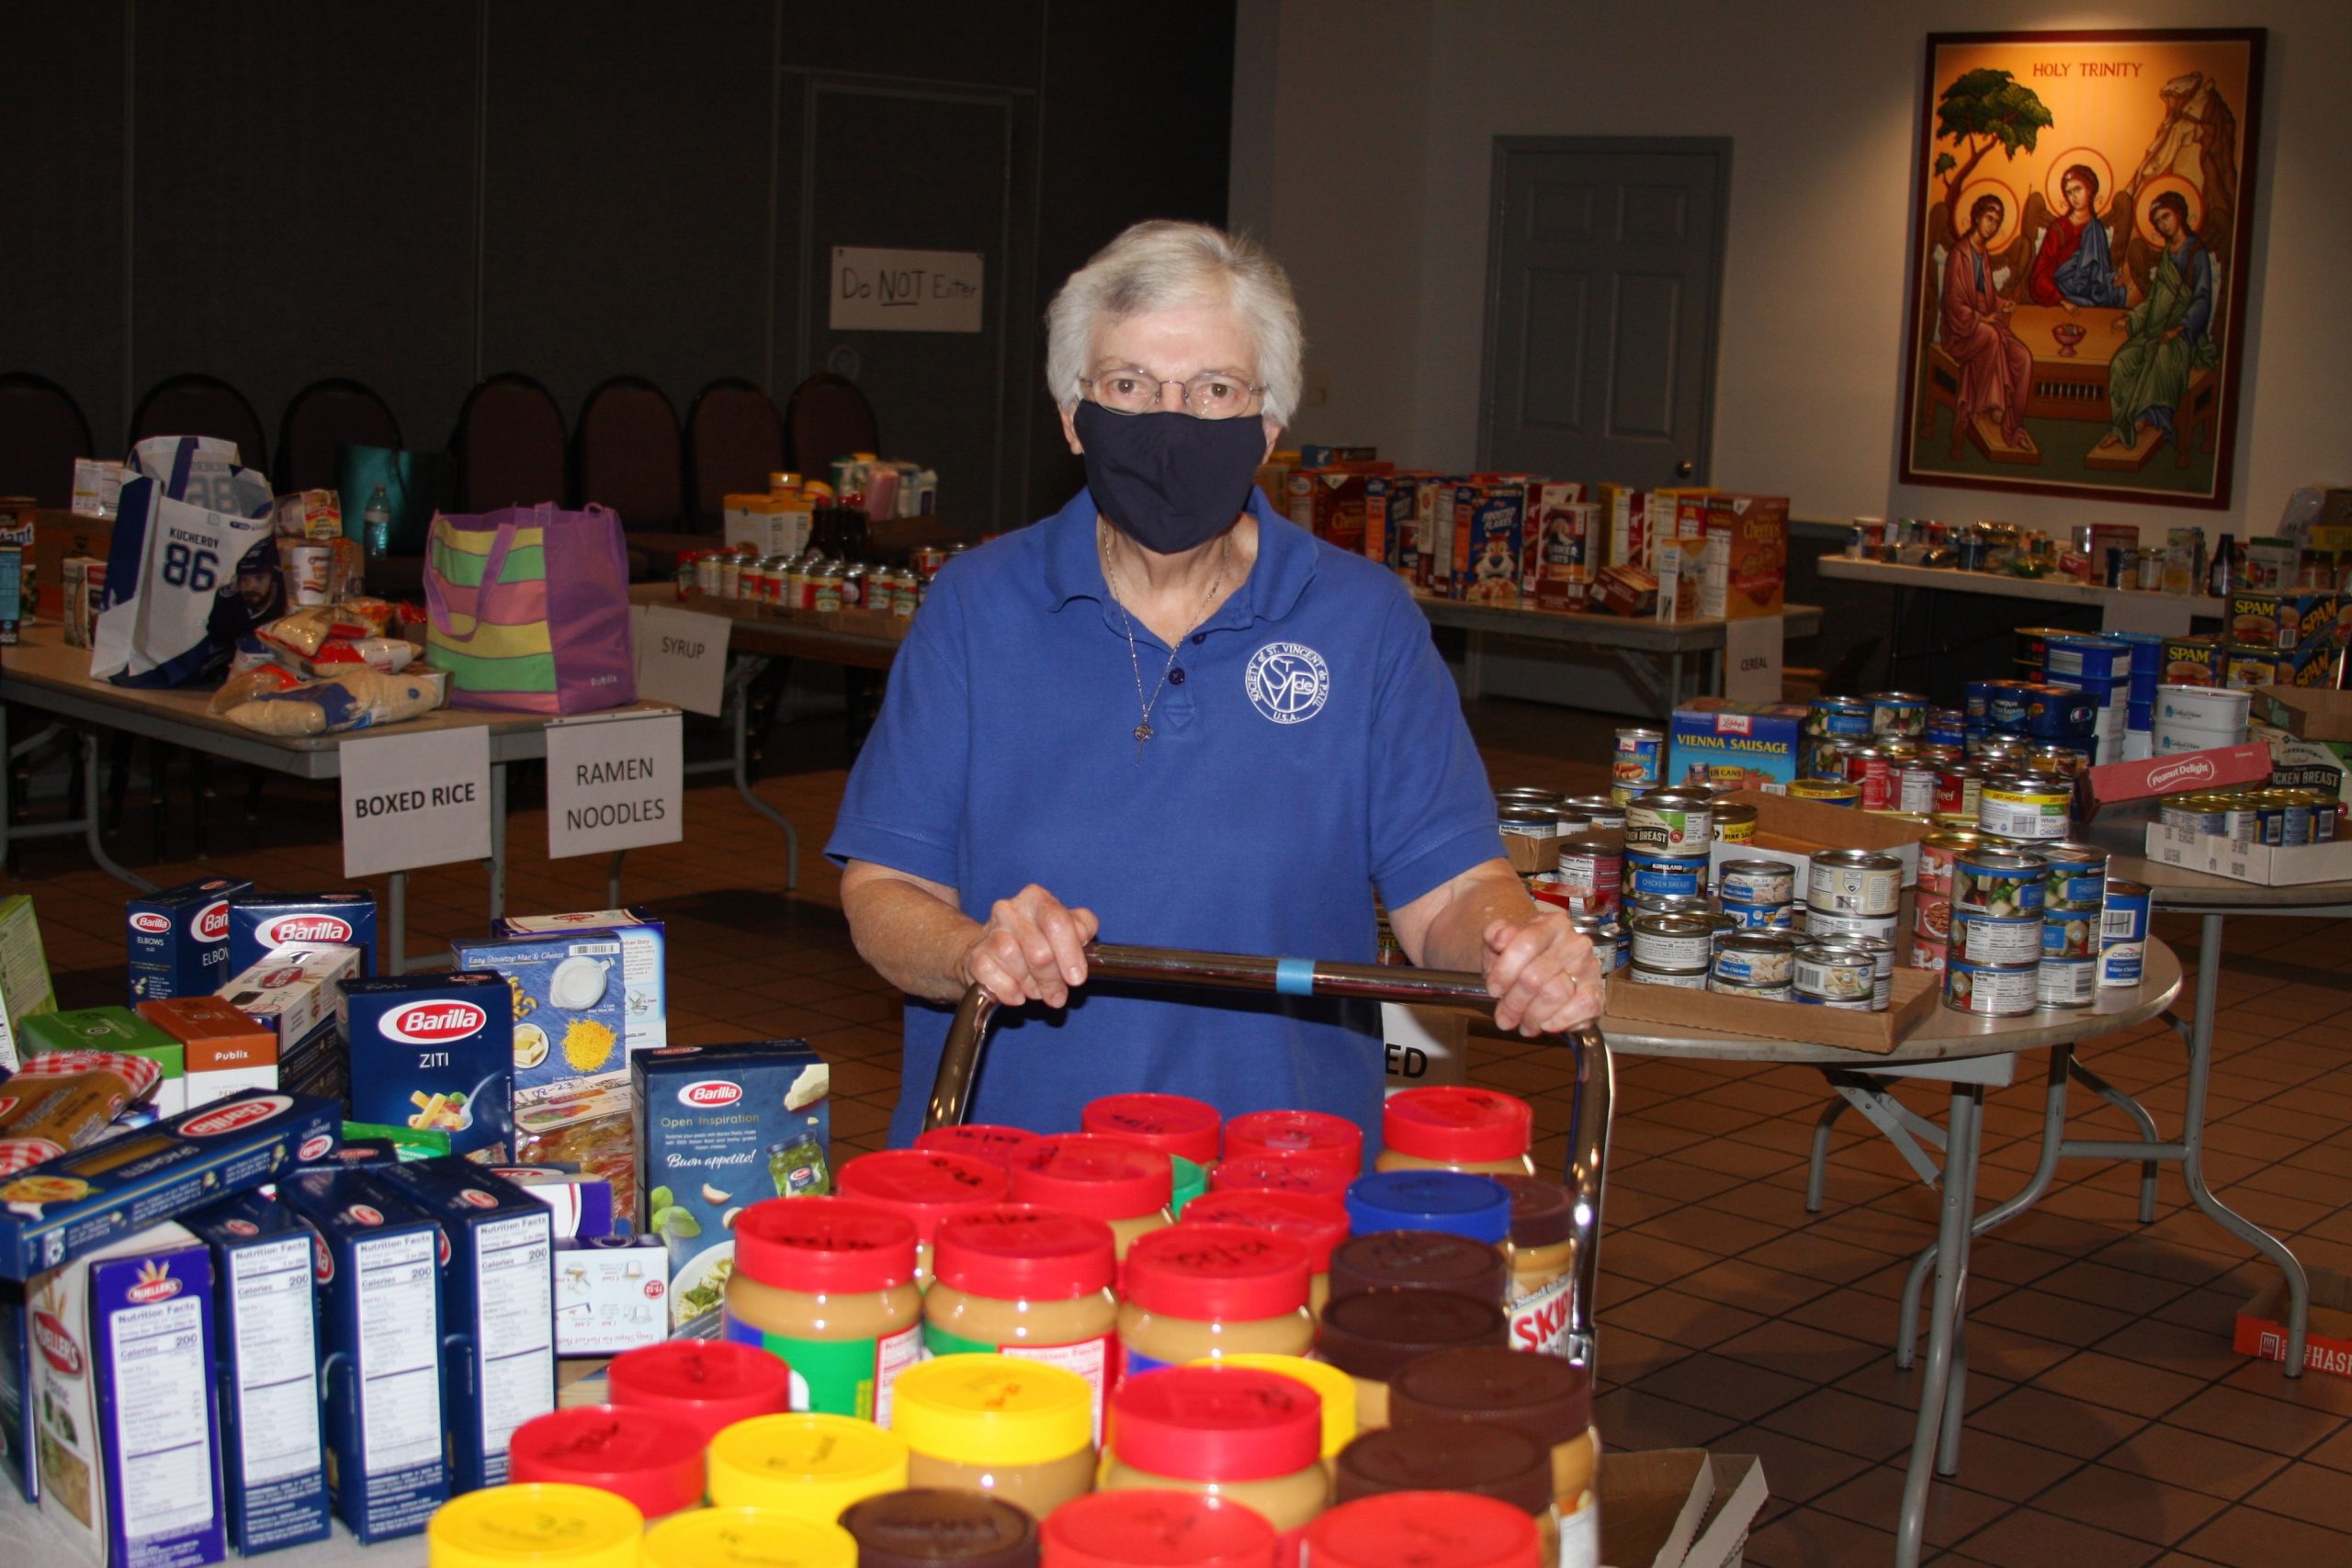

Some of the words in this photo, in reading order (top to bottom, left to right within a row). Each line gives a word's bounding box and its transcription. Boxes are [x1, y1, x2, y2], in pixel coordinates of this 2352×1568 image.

[2033, 63, 2071, 77] HOLY
[2079, 62, 2143, 77] TRINITY
[842, 267, 871, 299] Do
[878, 269, 926, 304] NOT
[933, 274, 978, 299] Enter
[1483, 507, 1516, 523] FROSTED
[1484, 516, 1514, 530] FLAKES
[169, 527, 220, 548] KUCHEROV
[1744, 521, 1781, 538] Cheerios
[163, 543, 219, 592] 86
[2234, 600, 2275, 616] SPAM
[2301, 598, 2339, 637] SPAM
[662, 637, 705, 660] SYRUP
[2169, 647, 2209, 662] SPAM
[1741, 659, 1768, 672] CEREAL
[2297, 650, 2330, 687] SPAM
[1283, 644, 1323, 668] VINCENT
[1312, 683, 1328, 707] PAUL
[1677, 734, 1725, 749] VIENNA
[1730, 738, 1789, 754] SAUSAGE
[577, 757, 653, 786] RAMEN
[1710, 768, 1719, 776] 18
[1720, 768, 1742, 777] CANS
[2152, 769, 2178, 785] Peanut
[2179, 761, 2211, 776] Delight
[2272, 771, 2298, 785] ICKEN
[2302, 771, 2339, 787] BREAST
[356, 790, 424, 818] BOXED
[432, 783, 476, 807] RICE
[1937, 788, 1956, 800] Beef
[568, 798, 665, 830] NOODLES
[1639, 829, 1668, 843] BREAST
[1724, 832, 1739, 840] PINK
[1642, 879, 1667, 887] CHICKEN
[1668, 881, 1690, 889] BREAST
[139, 918, 168, 929] Barilla
[205, 909, 229, 932] Bari
[277, 921, 345, 942] Barilla
[137, 937, 164, 947] ELBOWS
[469, 956, 486, 965] Easy
[517, 953, 532, 961] Mac
[404, 1009, 478, 1032] Barilla
[214, 1050, 249, 1060] Publix
[420, 1053, 449, 1068] ZITI
[693, 1086, 738, 1100] Barilla
[194, 1103, 269, 1134] Barilla
[662, 1117, 693, 1129] Open
[698, 1114, 760, 1126] Inspiration
[667, 1153, 702, 1168] Buon
[705, 1148, 758, 1169] appetito!
[481, 1222, 520, 1234] Nutrition
[522, 1216, 547, 1227] Facts
[236, 1247, 277, 1259] Nutrition
[281, 1241, 307, 1252] Facts
[360, 1240, 402, 1252] Nutrition
[405, 1235, 431, 1245] Facts
[481, 1258, 514, 1270] Calories
[528, 1248, 548, 1260] 200
[238, 1283, 273, 1296] Calories
[289, 1274, 309, 1286] 200
[362, 1276, 396, 1288] Calories
[412, 1267, 432, 1279] 200
[132, 1281, 177, 1299] MUELLER'S
[118, 1309, 164, 1325] Nutrition
[167, 1302, 196, 1314] Facts
[120, 1345, 159, 1359] Calories
[176, 1334, 198, 1348] 200
